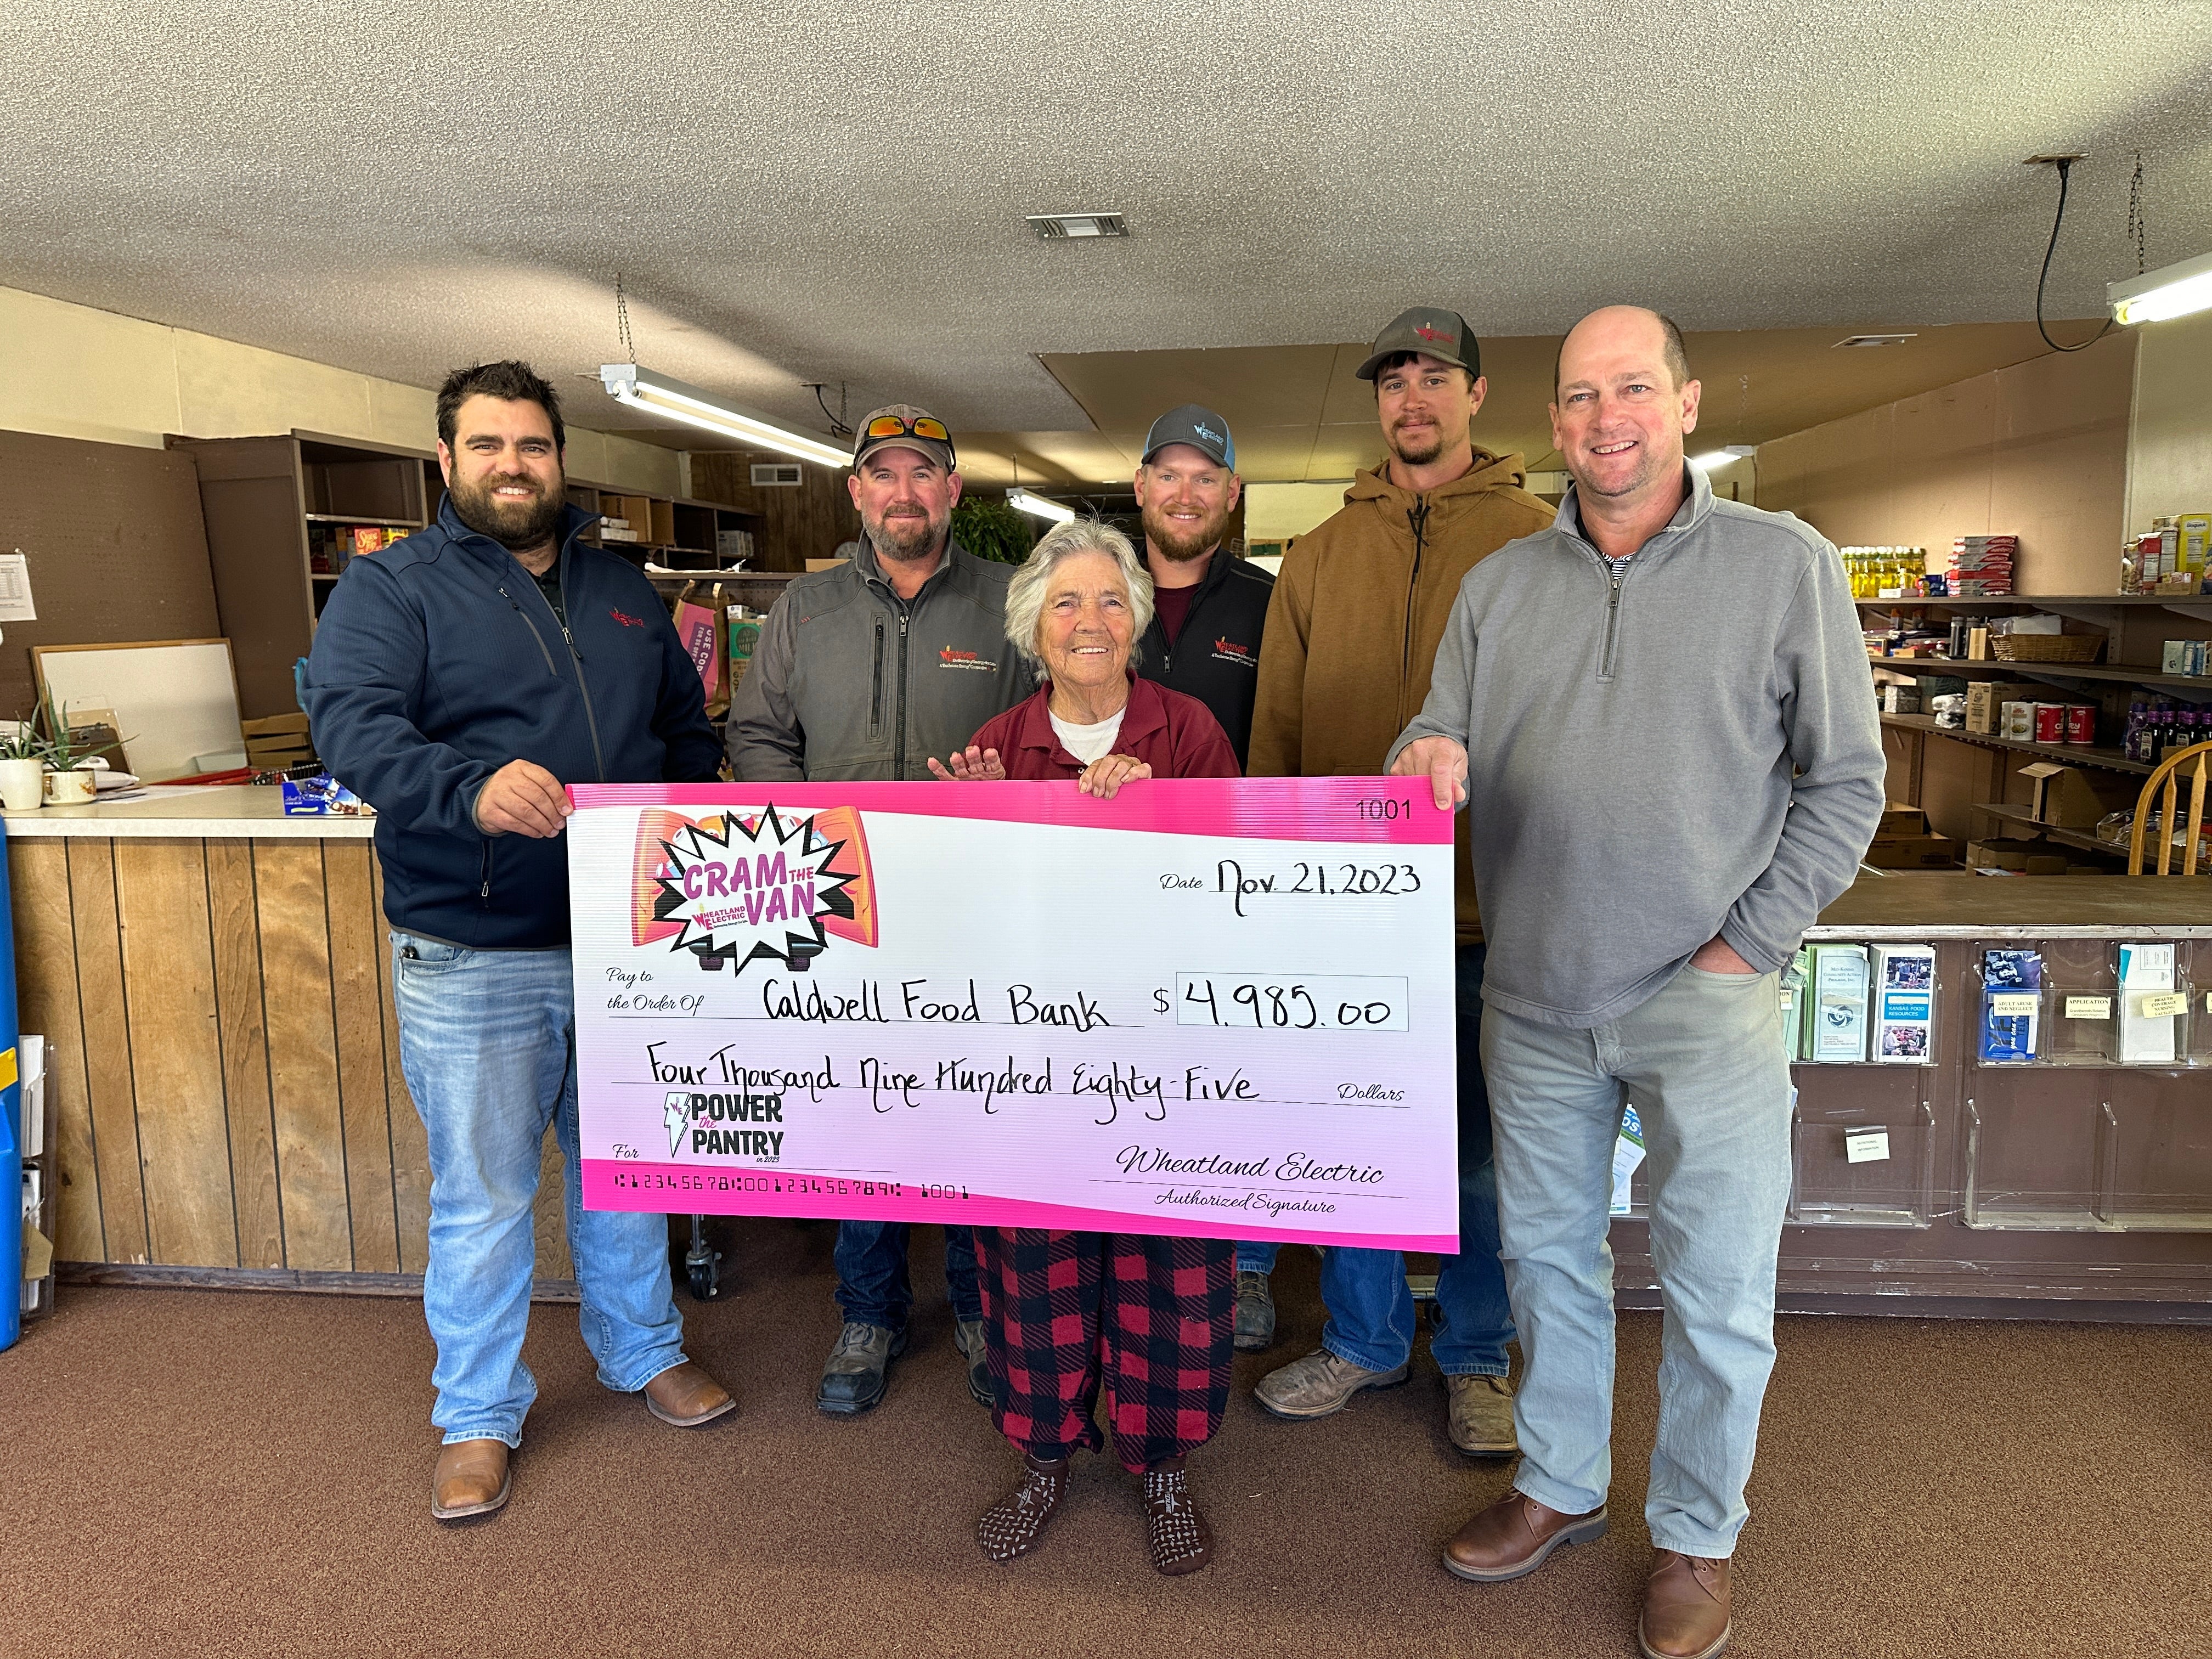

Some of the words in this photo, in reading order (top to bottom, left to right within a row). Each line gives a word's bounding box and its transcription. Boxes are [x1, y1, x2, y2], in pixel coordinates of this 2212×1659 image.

[1356, 799, 1411, 820] 1001
[684, 851, 787, 900] CRAM
[789, 866, 814, 883] THE
[1160, 873, 1203, 889] Date
[744, 882, 815, 926] VAN
[691, 906, 745, 928] WHEATLAND
[705, 913, 746, 930] ELECTRIC
[606, 968, 638, 989] Pay
[640, 970, 653, 982] to
[607, 995, 629, 1009] the
[633, 995, 677, 1011] Order
[680, 995, 704, 1016] Of
[763, 979, 890, 1024] Caldwell
[901, 979, 980, 1022] Food
[1007, 984, 1110, 1032] Bank
[646, 1041, 707, 1084] Four
[708, 1043, 840, 1103] Thousand
[936, 1056, 1052, 1114] Hundred
[1337, 1083, 1404, 1102] Dollars
[691, 1093, 782, 1122] POWER
[698, 1113, 717, 1128] the
[612, 1144, 640, 1159] For
[692, 1130, 784, 1155] PANTRY
[1116, 1145, 1269, 1179] Wheatland
[1274, 1152, 1385, 1185] Electric
[921, 1185, 969, 1199] 1001
[1154, 1188, 1251, 1211] Authorized
[1252, 1192, 1336, 1218] Signature
